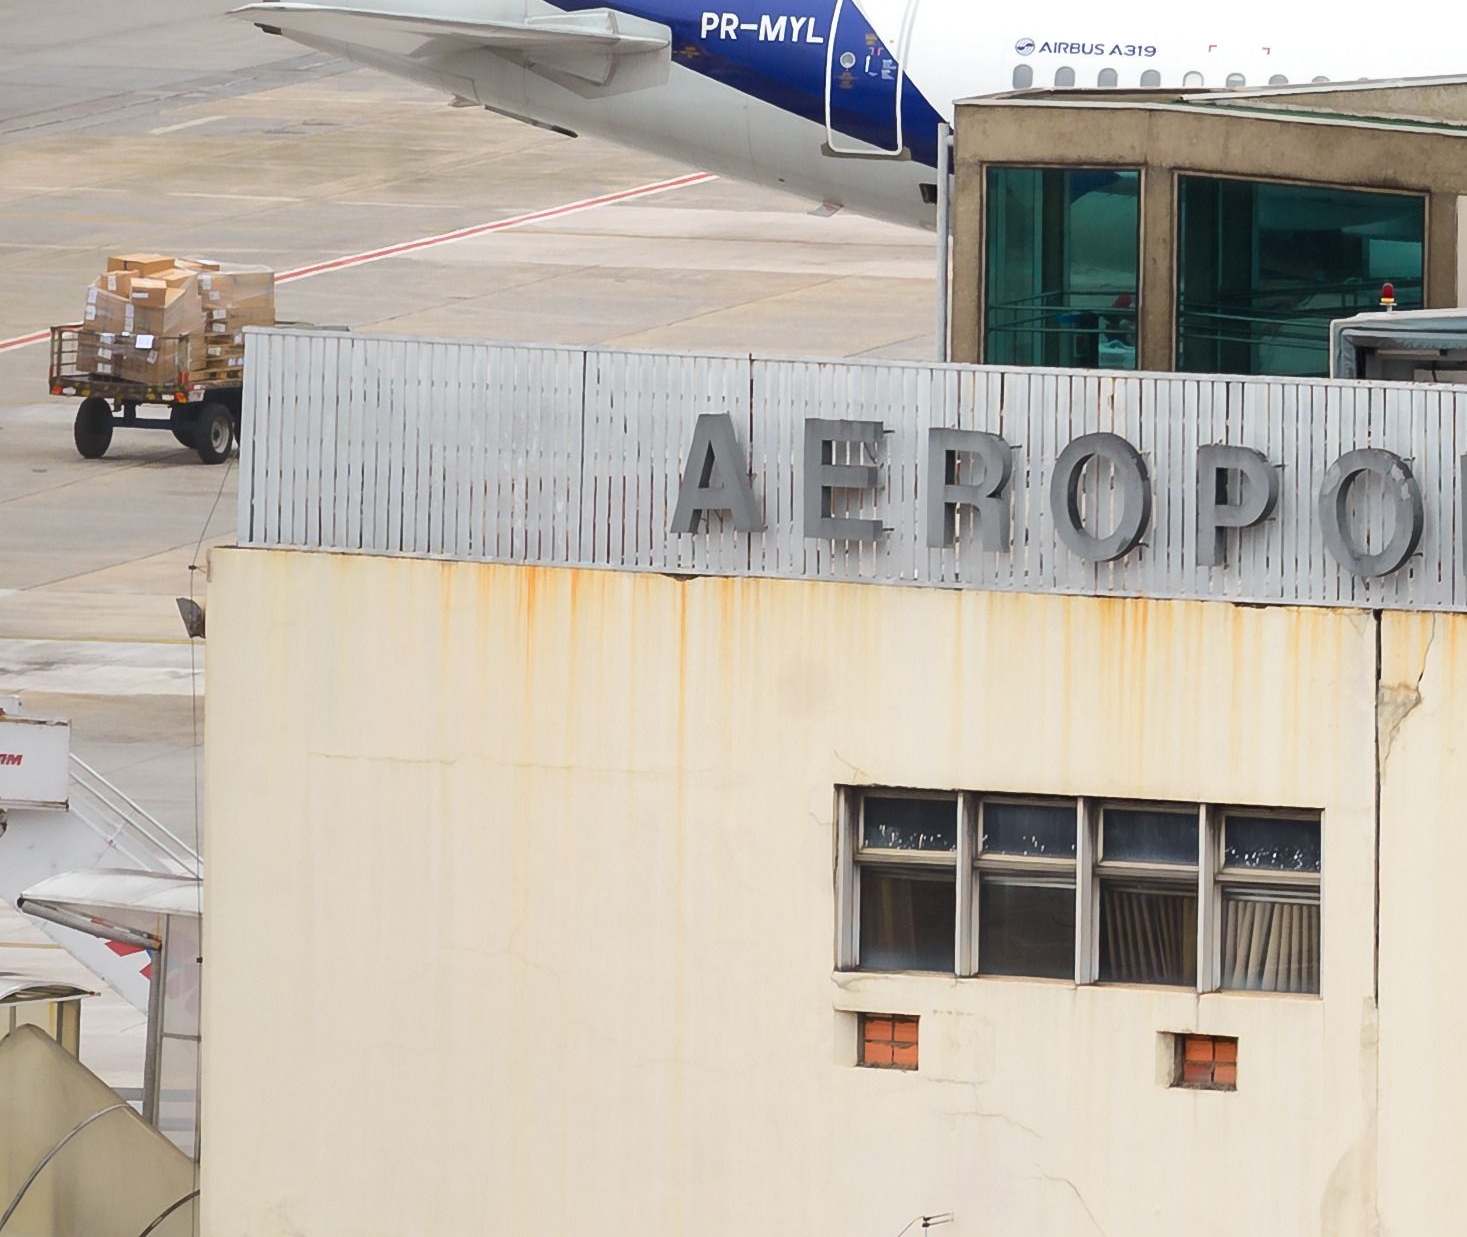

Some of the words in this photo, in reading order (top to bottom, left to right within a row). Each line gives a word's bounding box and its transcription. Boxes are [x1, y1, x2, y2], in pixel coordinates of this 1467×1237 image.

[700, 11, 825, 44] PR-MYL
[1038, 41, 1105, 56] AIRBUS
[1108, 43, 1157, 58] A319
